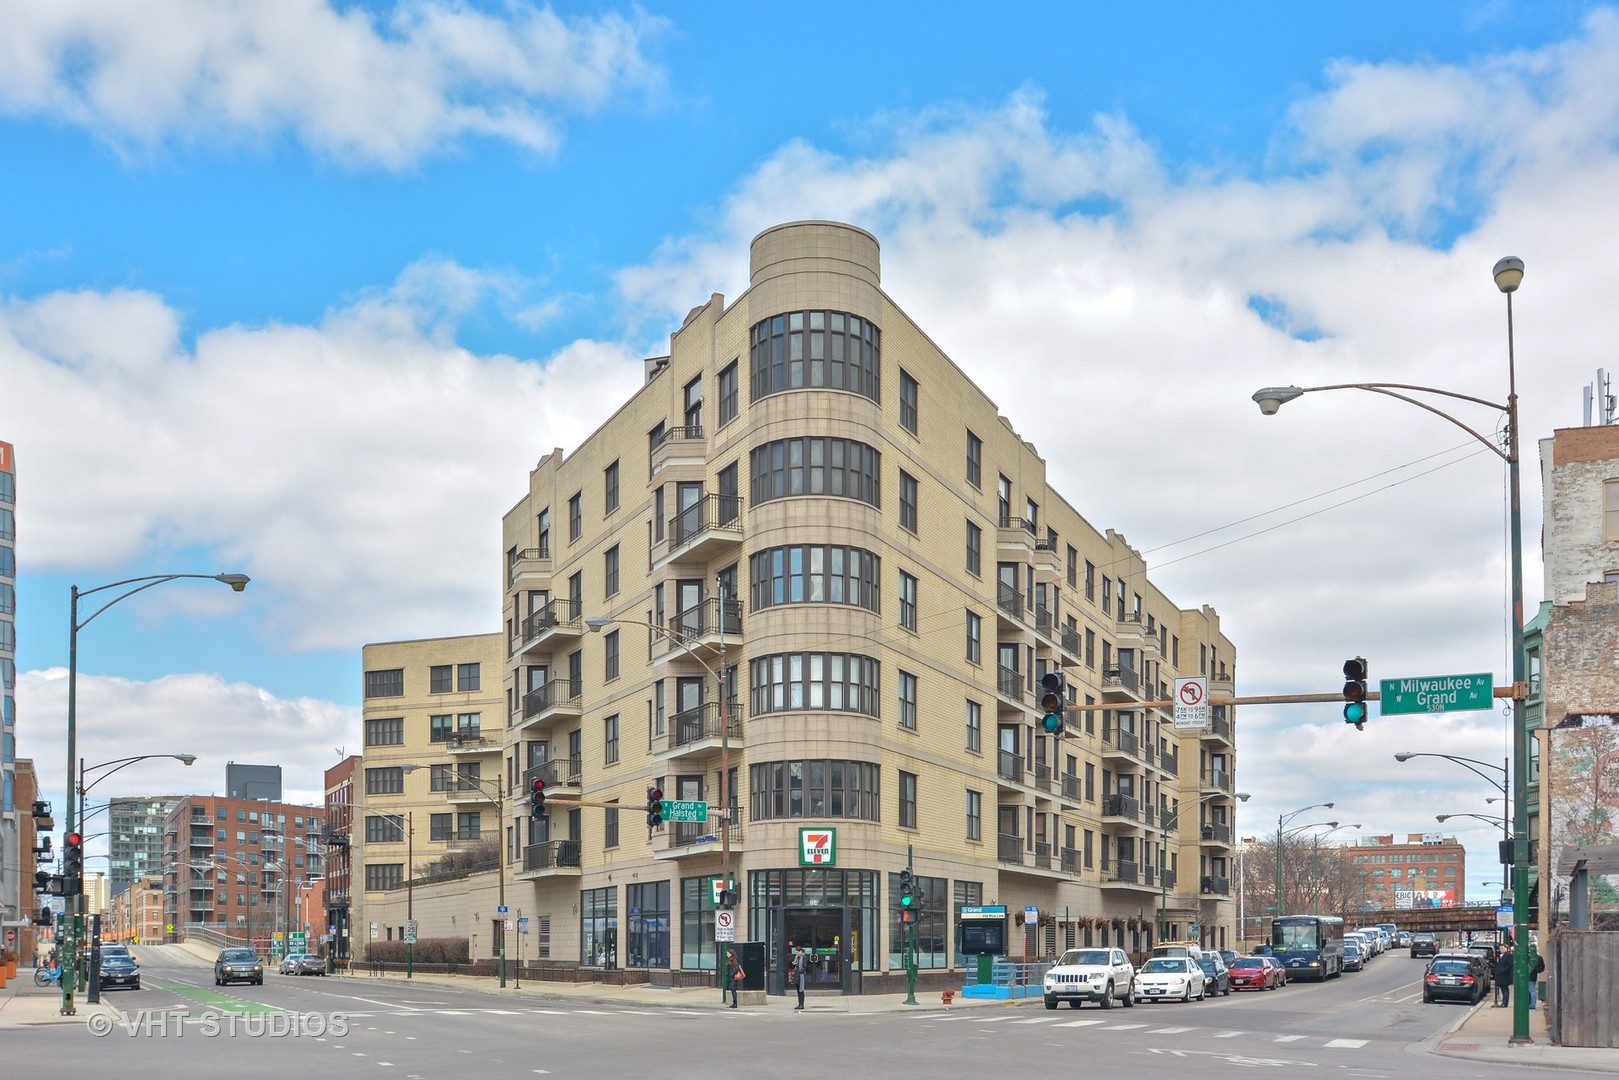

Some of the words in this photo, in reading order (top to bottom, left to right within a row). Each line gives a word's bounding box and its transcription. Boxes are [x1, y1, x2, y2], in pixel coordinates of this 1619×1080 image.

[1389, 683, 1395, 691] N
[1400, 677, 1471, 693] Milwaukee
[1476, 678, 1485, 686] Av
[1396, 695, 1402, 703] W
[1416, 691, 1457, 705] Grand
[1469, 692, 1478, 700] Av
[672, 801, 694, 809] Grand
[670, 809, 697, 818] Halsted
